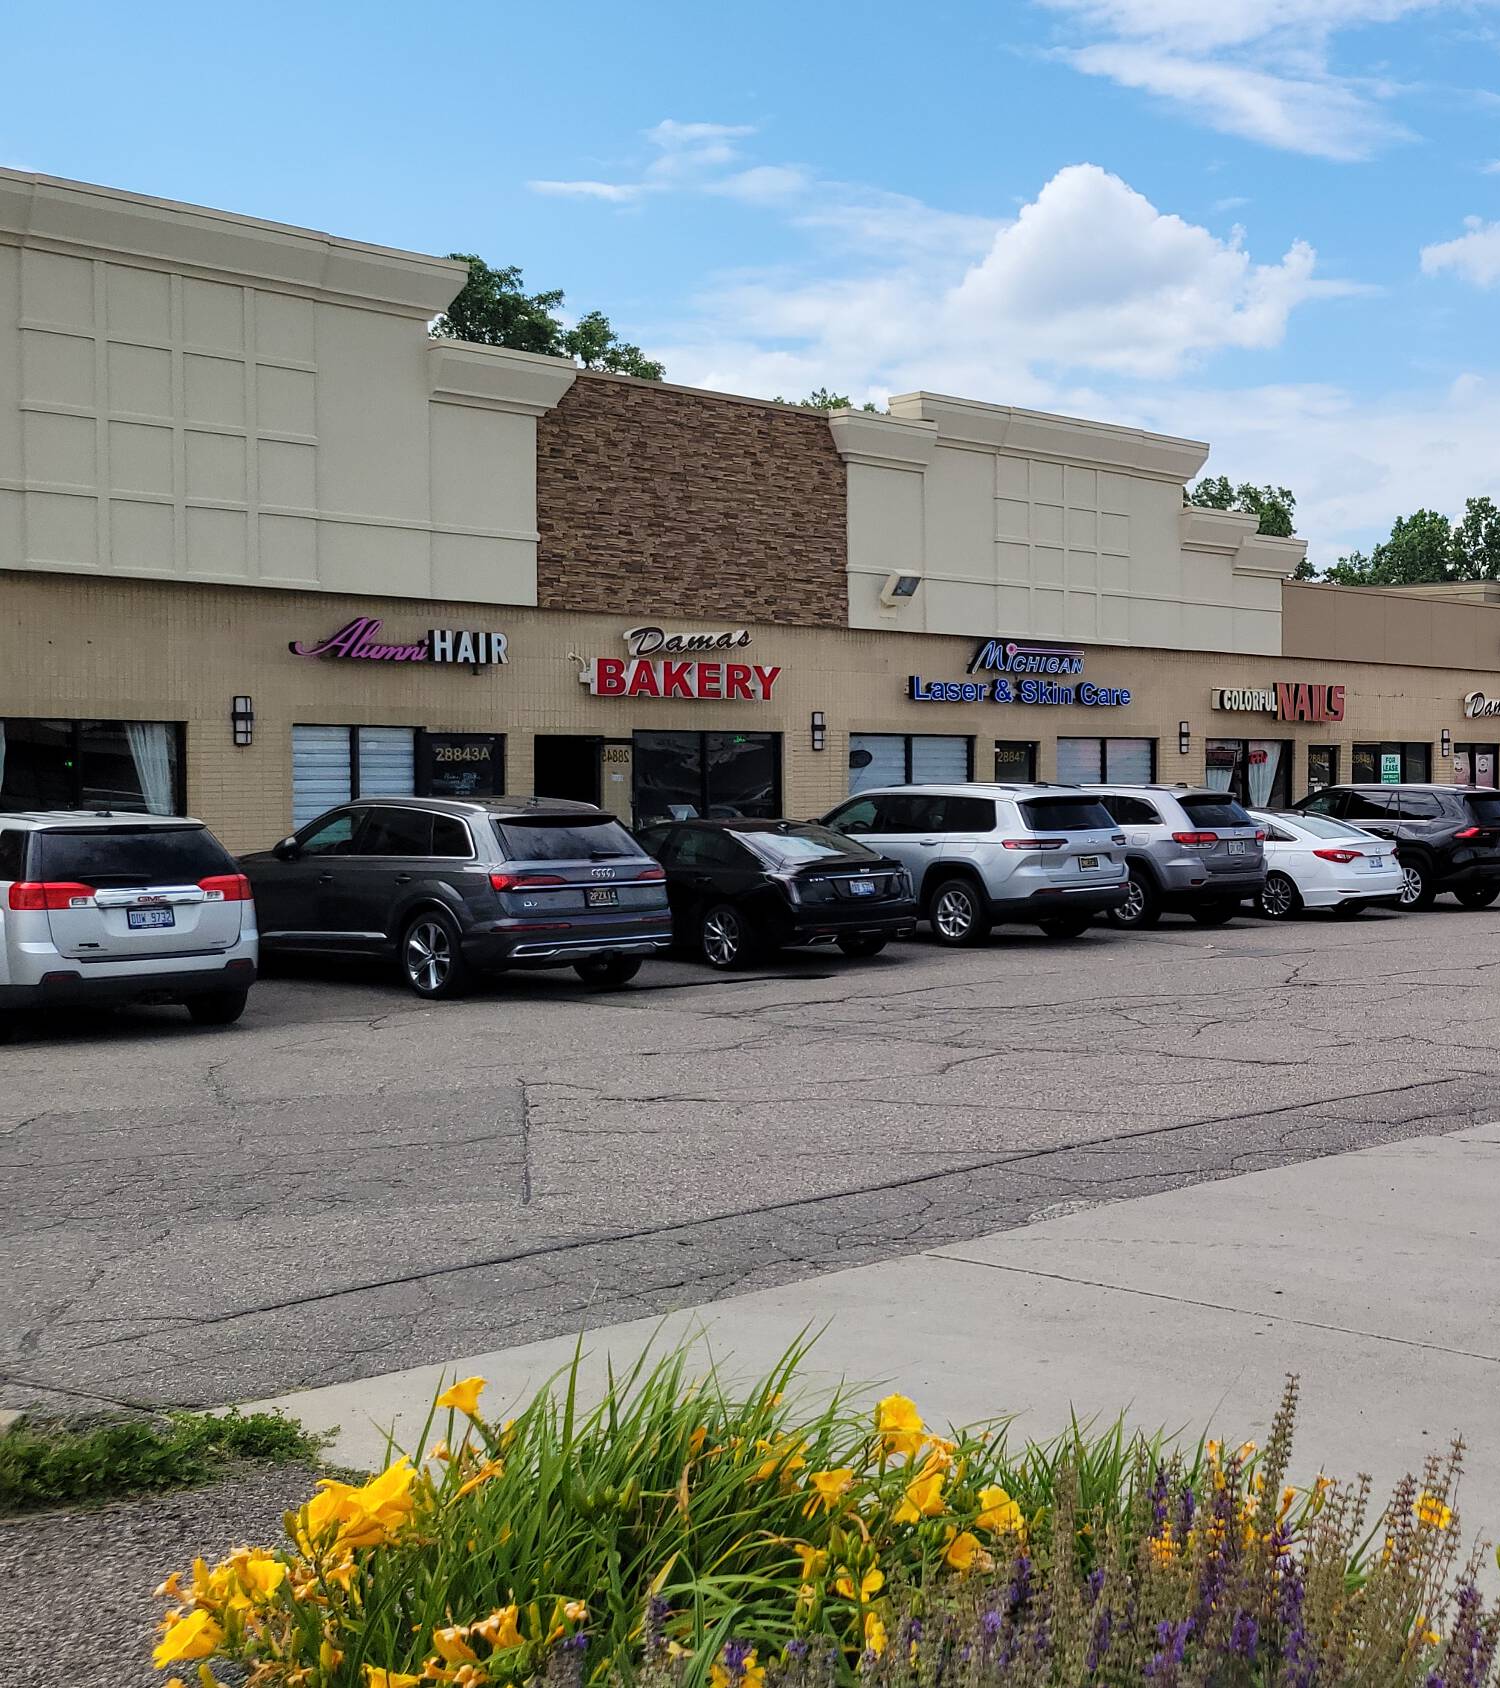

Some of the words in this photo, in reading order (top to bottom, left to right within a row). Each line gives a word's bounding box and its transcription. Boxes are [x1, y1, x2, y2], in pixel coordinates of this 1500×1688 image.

[290, 616, 430, 661] Alumni
[431, 629, 509, 664] HAIR
[624, 625, 753, 656] Damas
[595, 657, 782, 701] BAKERY
[913, 675, 988, 702] Laser
[994, 678, 1014, 703] &
[1021, 679, 1074, 705] Skin
[1080, 682, 1132, 706] Care
[1223, 689, 1278, 712] COLORFUL
[1274, 682, 1346, 722] NAILS
[435, 747, 491, 761] 28843A
[997, 750, 1026, 764] 28847
[1383, 764, 1399, 772] LEASE
[137, 895, 167, 903] GMC
